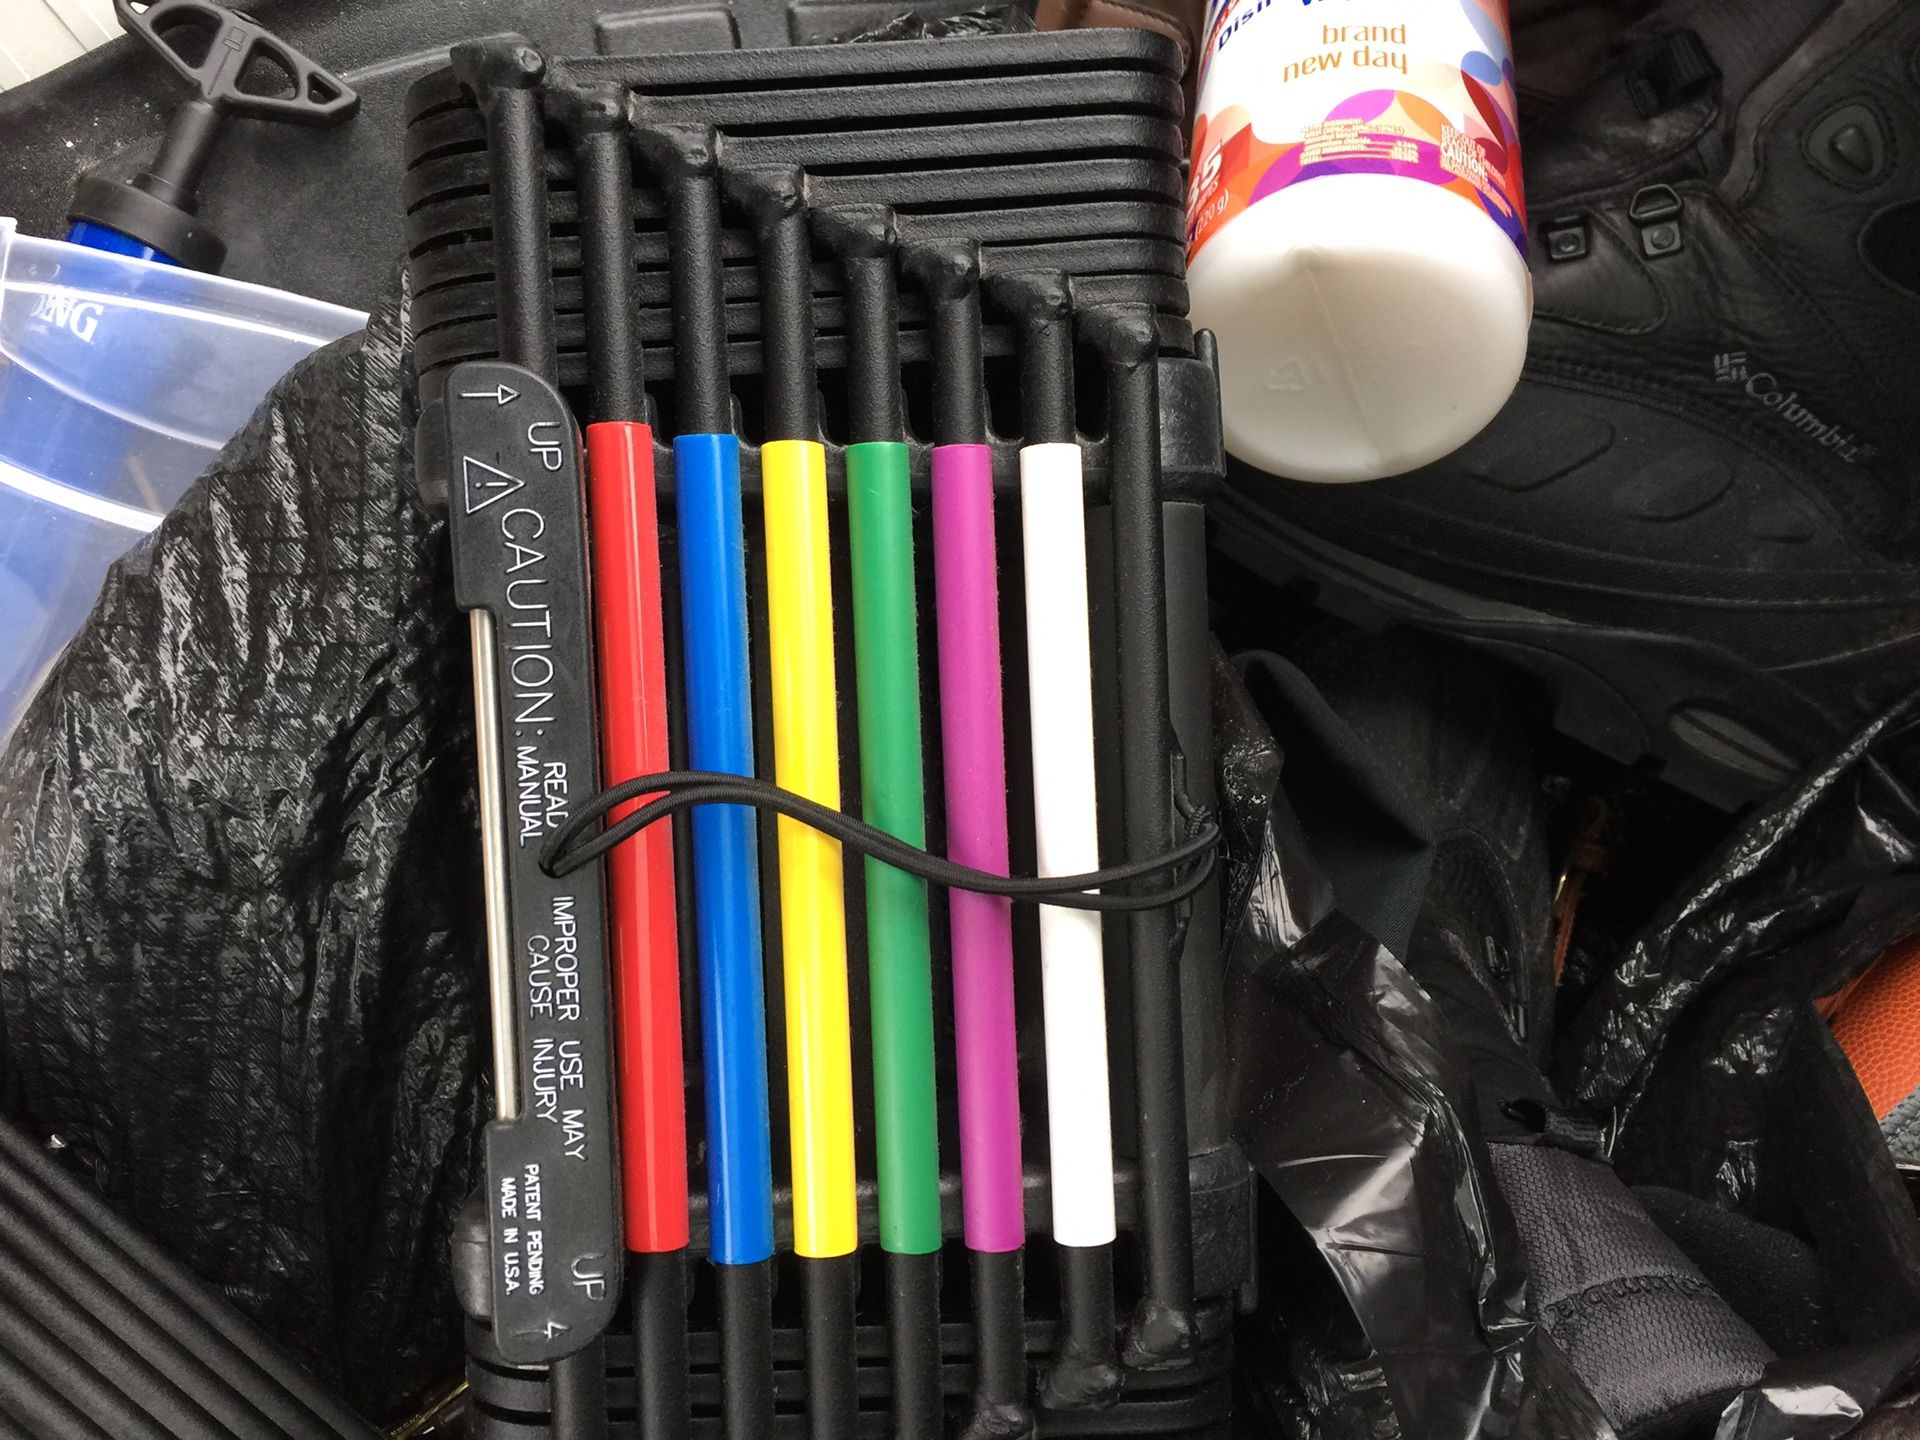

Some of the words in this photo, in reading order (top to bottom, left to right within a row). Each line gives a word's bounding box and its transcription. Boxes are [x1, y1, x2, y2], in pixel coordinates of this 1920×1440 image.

[1322, 24, 1407, 45] brand
[1283, 51, 1342, 83] new
[1352, 46, 1408, 75] day
[528, 421, 562, 471] UP
[502, 508, 556, 738] CAUTION:
[516, 746, 543, 848] MANUAL
[527, 934, 553, 1020] CAUSE
[552, 896, 581, 1022] IMPROPER
[532, 1037, 558, 1124] INJURY
[558, 1040, 584, 1092] USE
[562, 1108, 588, 1161] MAY
[500, 1176, 518, 1219] MADE
[524, 1163, 542, 1222] PATENT
[503, 1227, 519, 1244] IN
[527, 1229, 545, 1296] PENDING
[570, 1253, 606, 1302] UP
